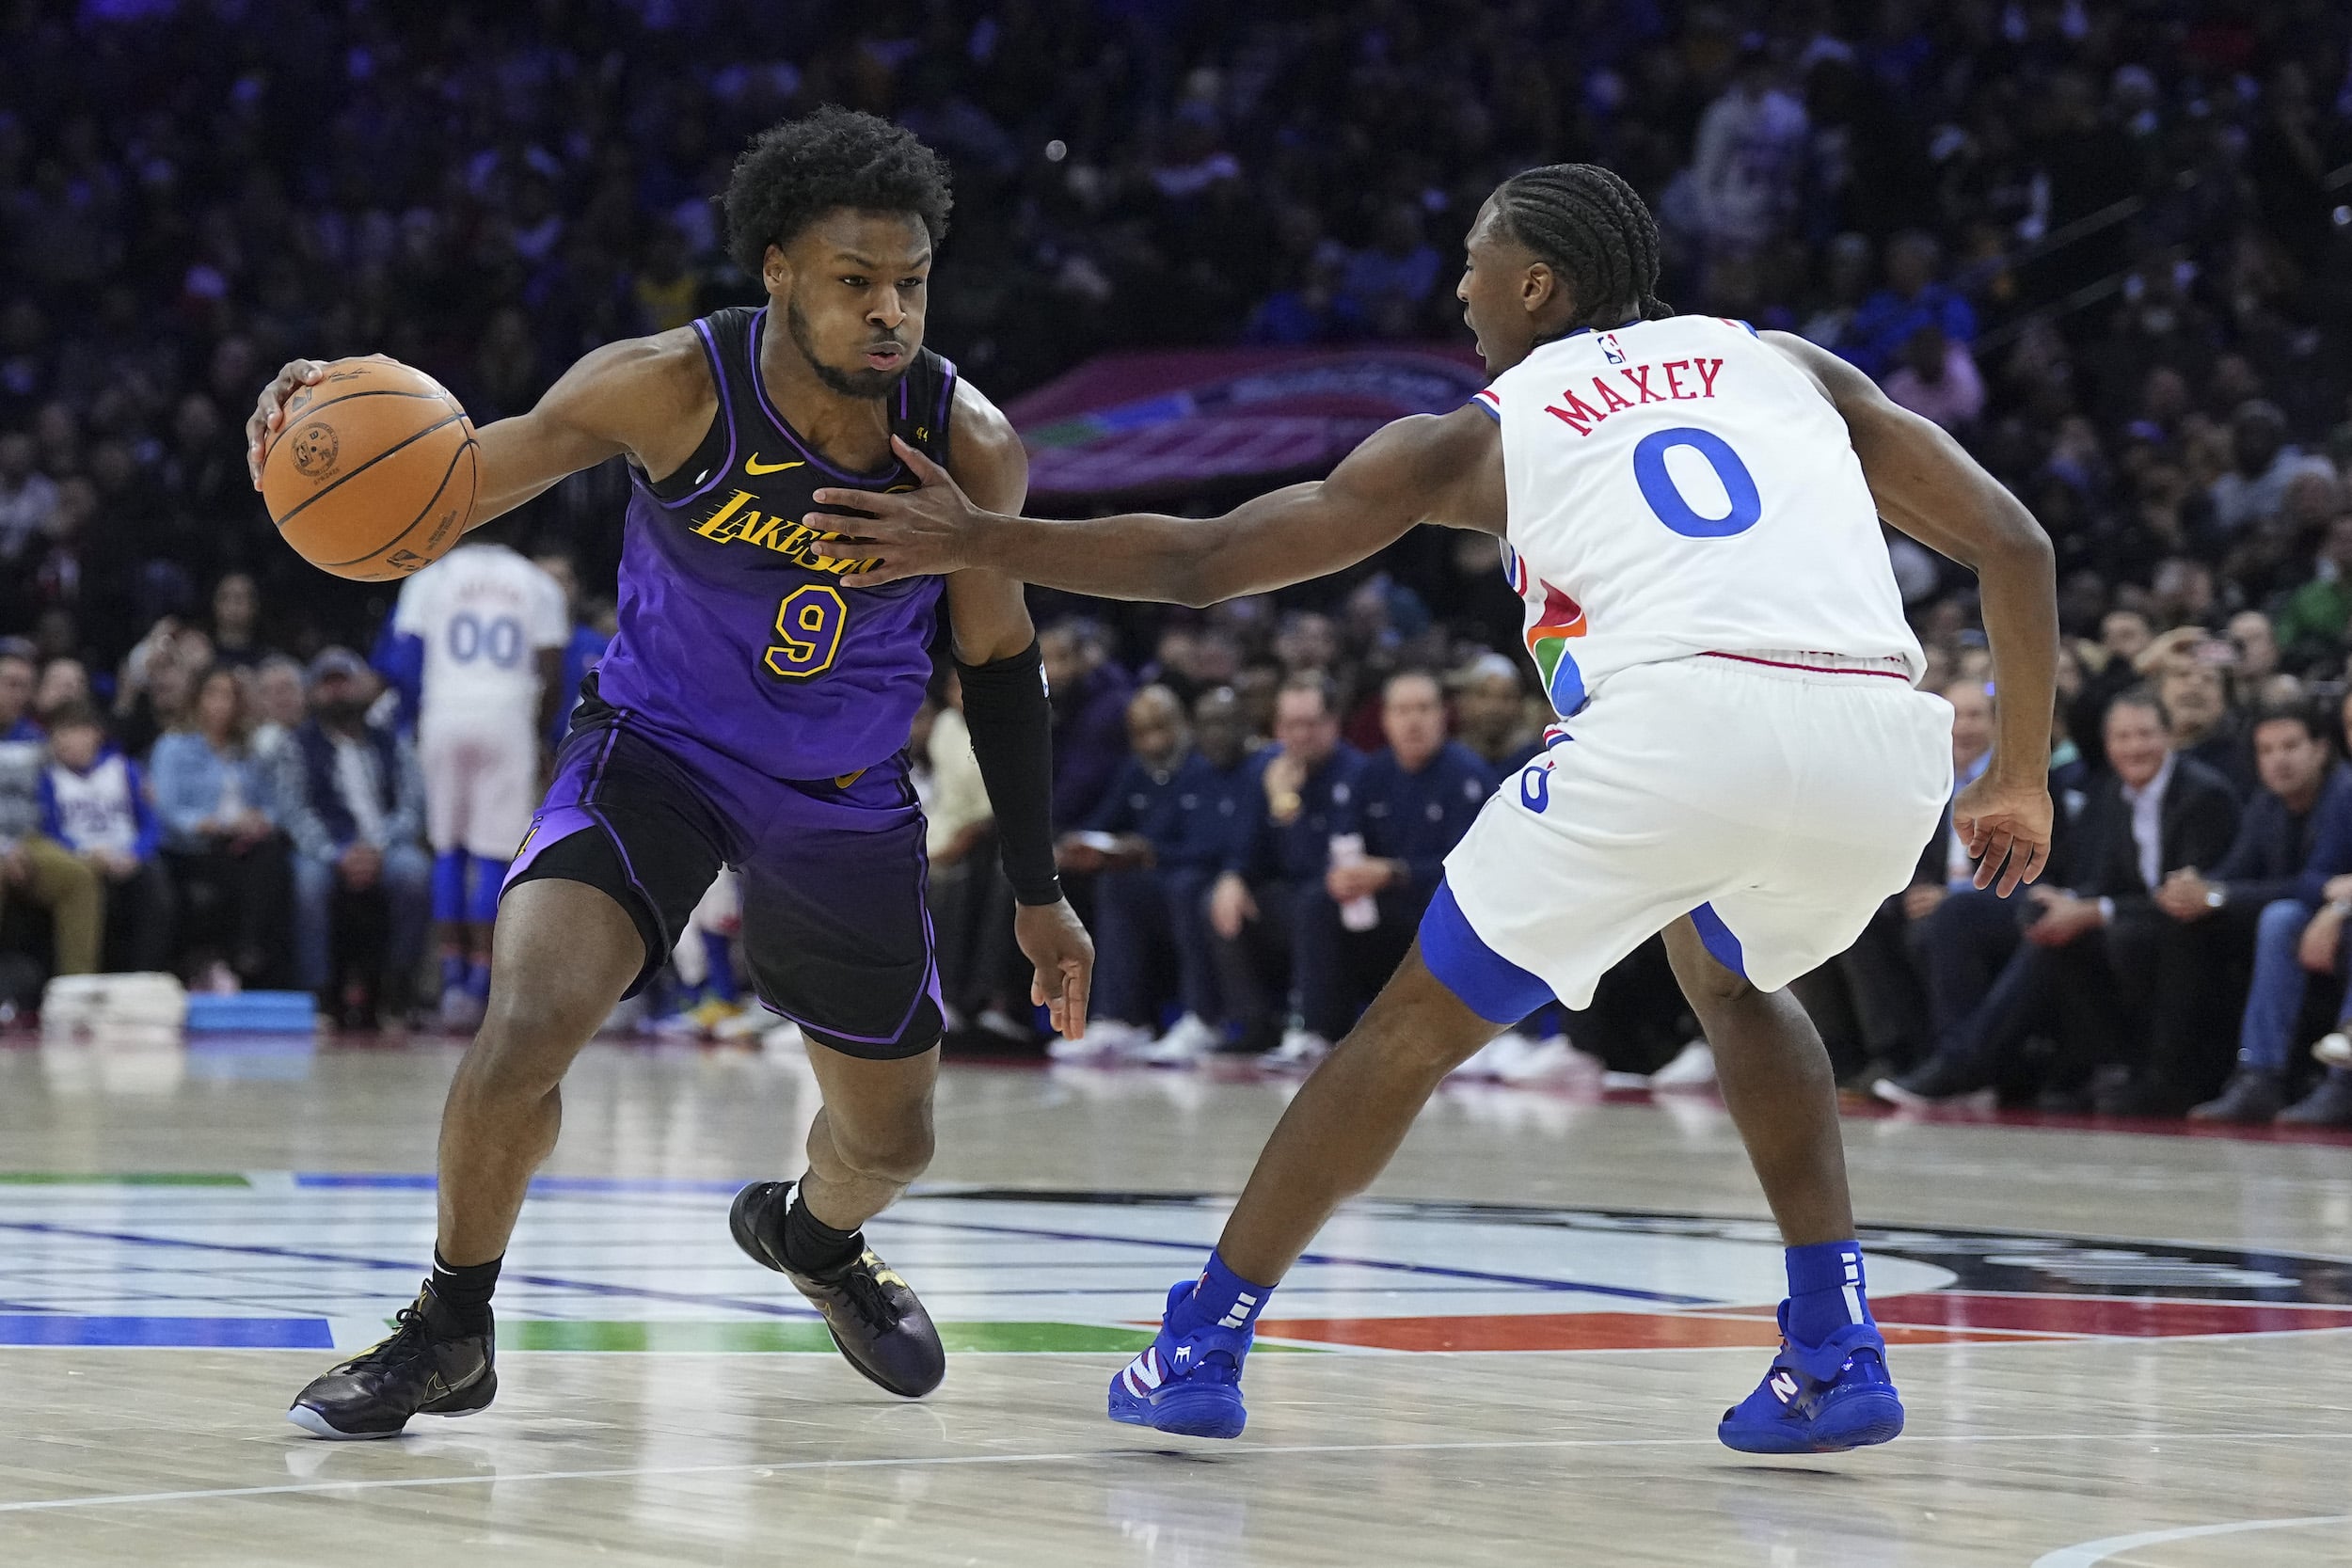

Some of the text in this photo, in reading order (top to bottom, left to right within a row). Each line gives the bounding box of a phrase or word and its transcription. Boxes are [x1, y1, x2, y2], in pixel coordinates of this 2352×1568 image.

[1544, 357, 1724, 436] MAXEY
[1633, 427, 1761, 538] 0
[448, 611, 523, 669] 00
[764, 584, 848, 676] 9
